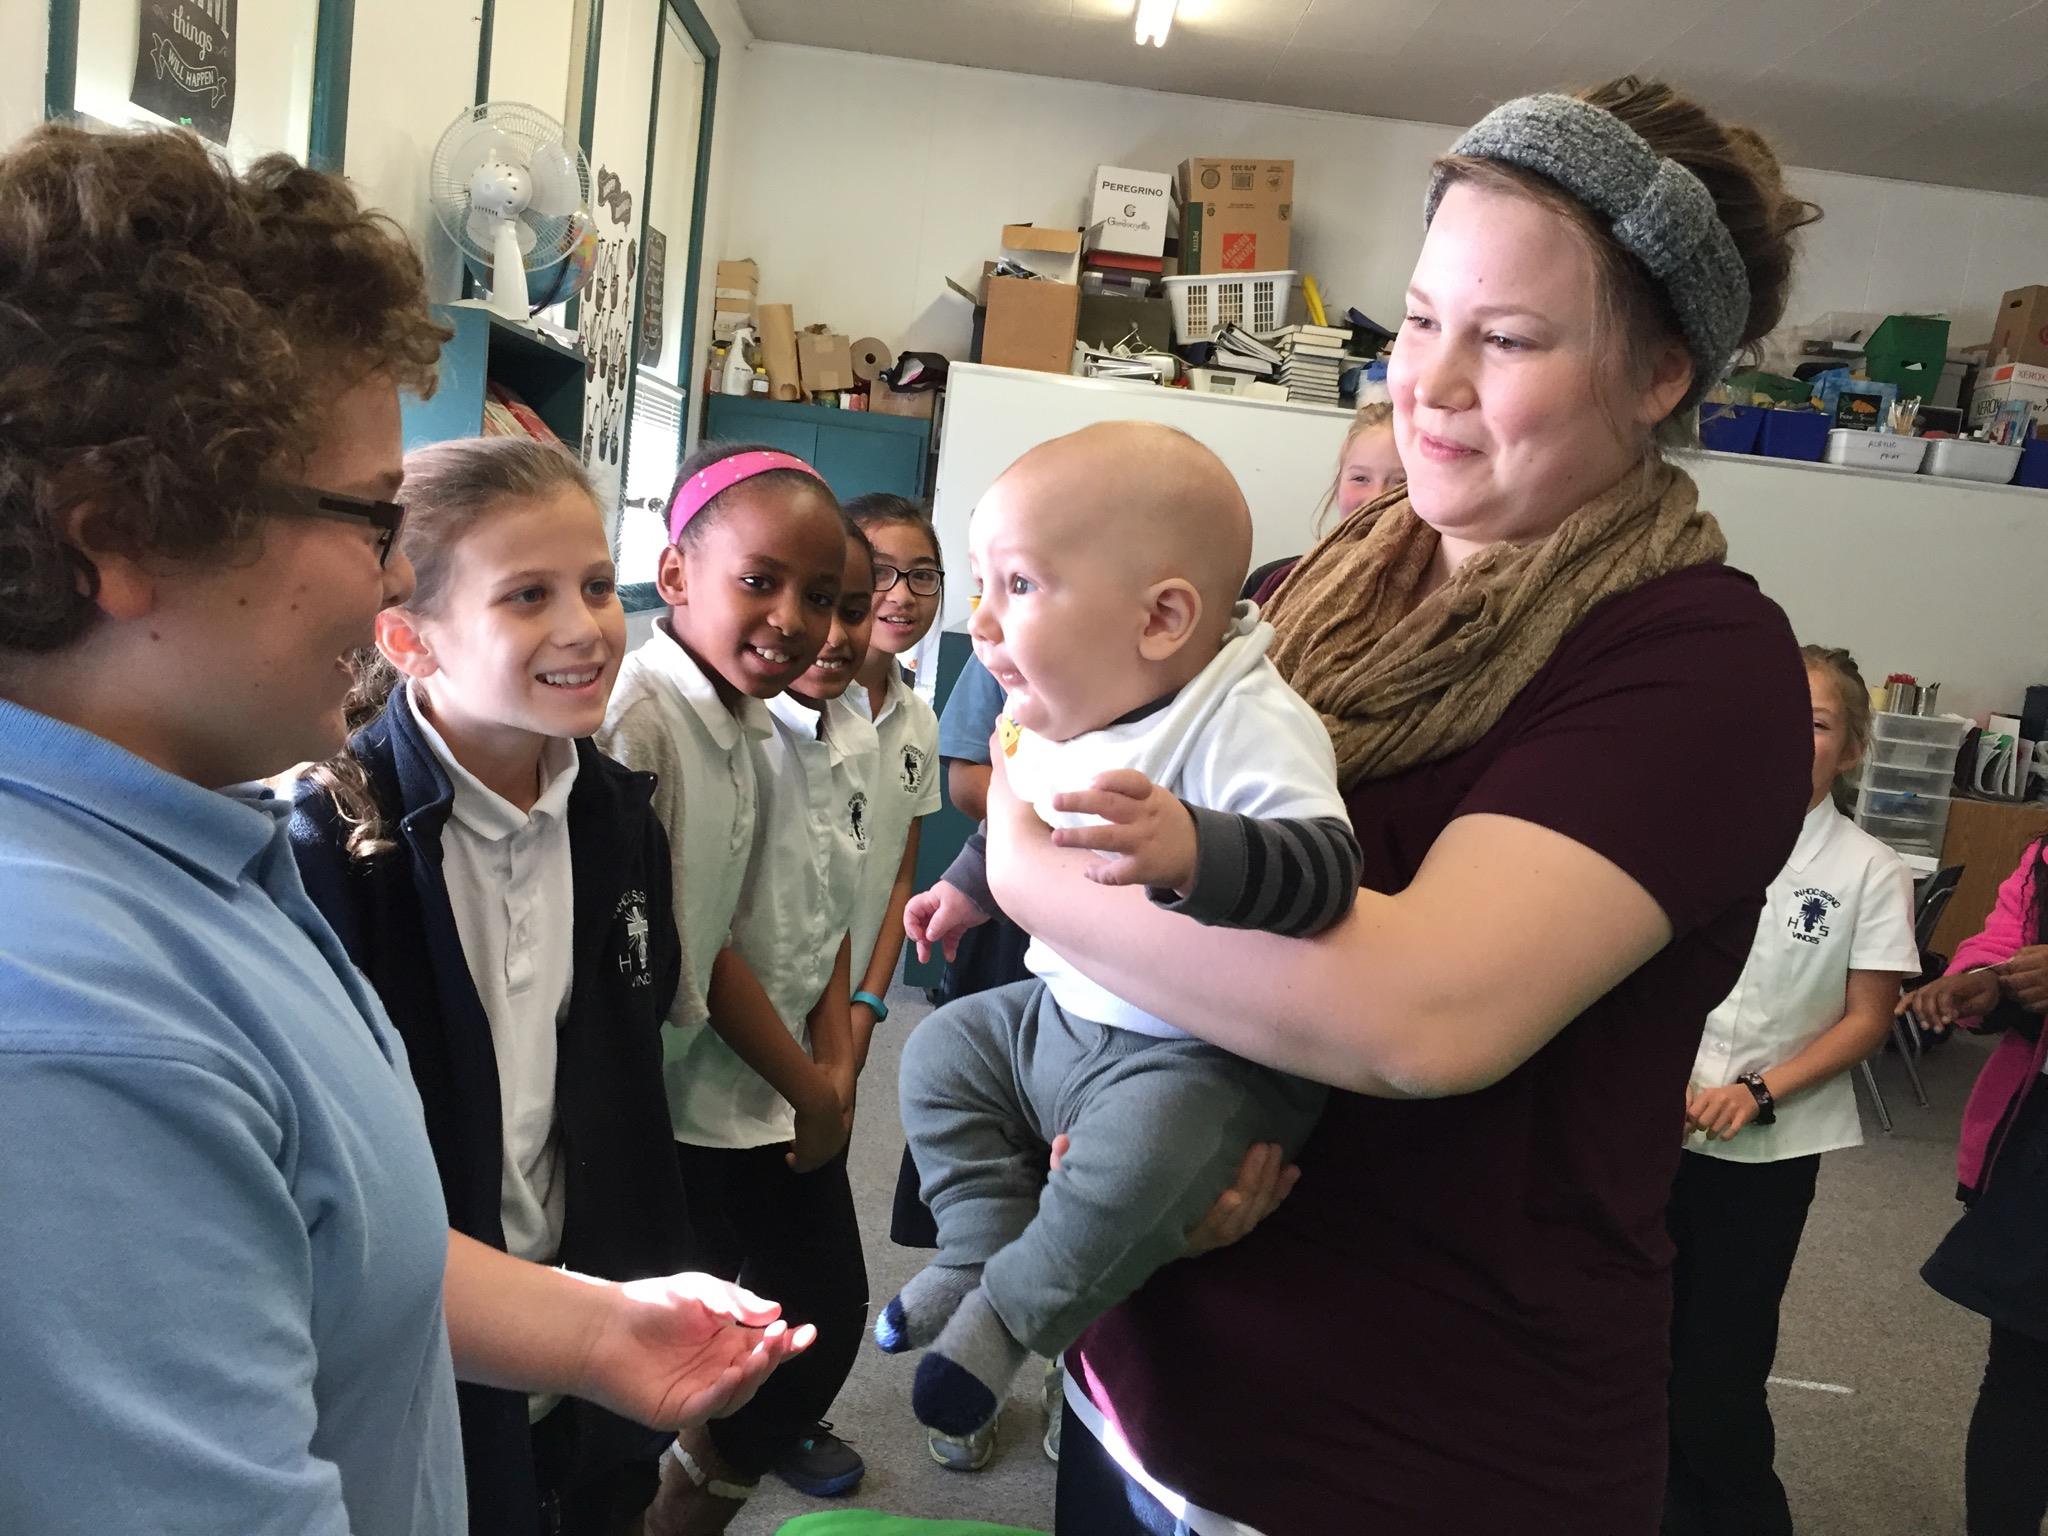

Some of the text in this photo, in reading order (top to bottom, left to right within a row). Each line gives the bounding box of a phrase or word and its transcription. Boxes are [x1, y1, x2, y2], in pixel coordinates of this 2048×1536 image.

[171, 5, 213, 60] things
[168, 48, 214, 87] WILL HAPPEN
[1102, 180, 1164, 197] PEREGRINO
[1123, 203, 1137, 218] G
[1819, 890, 1841, 908] SIGNO
[1787, 916, 1830, 937] H S
[619, 953, 632, 973] H
